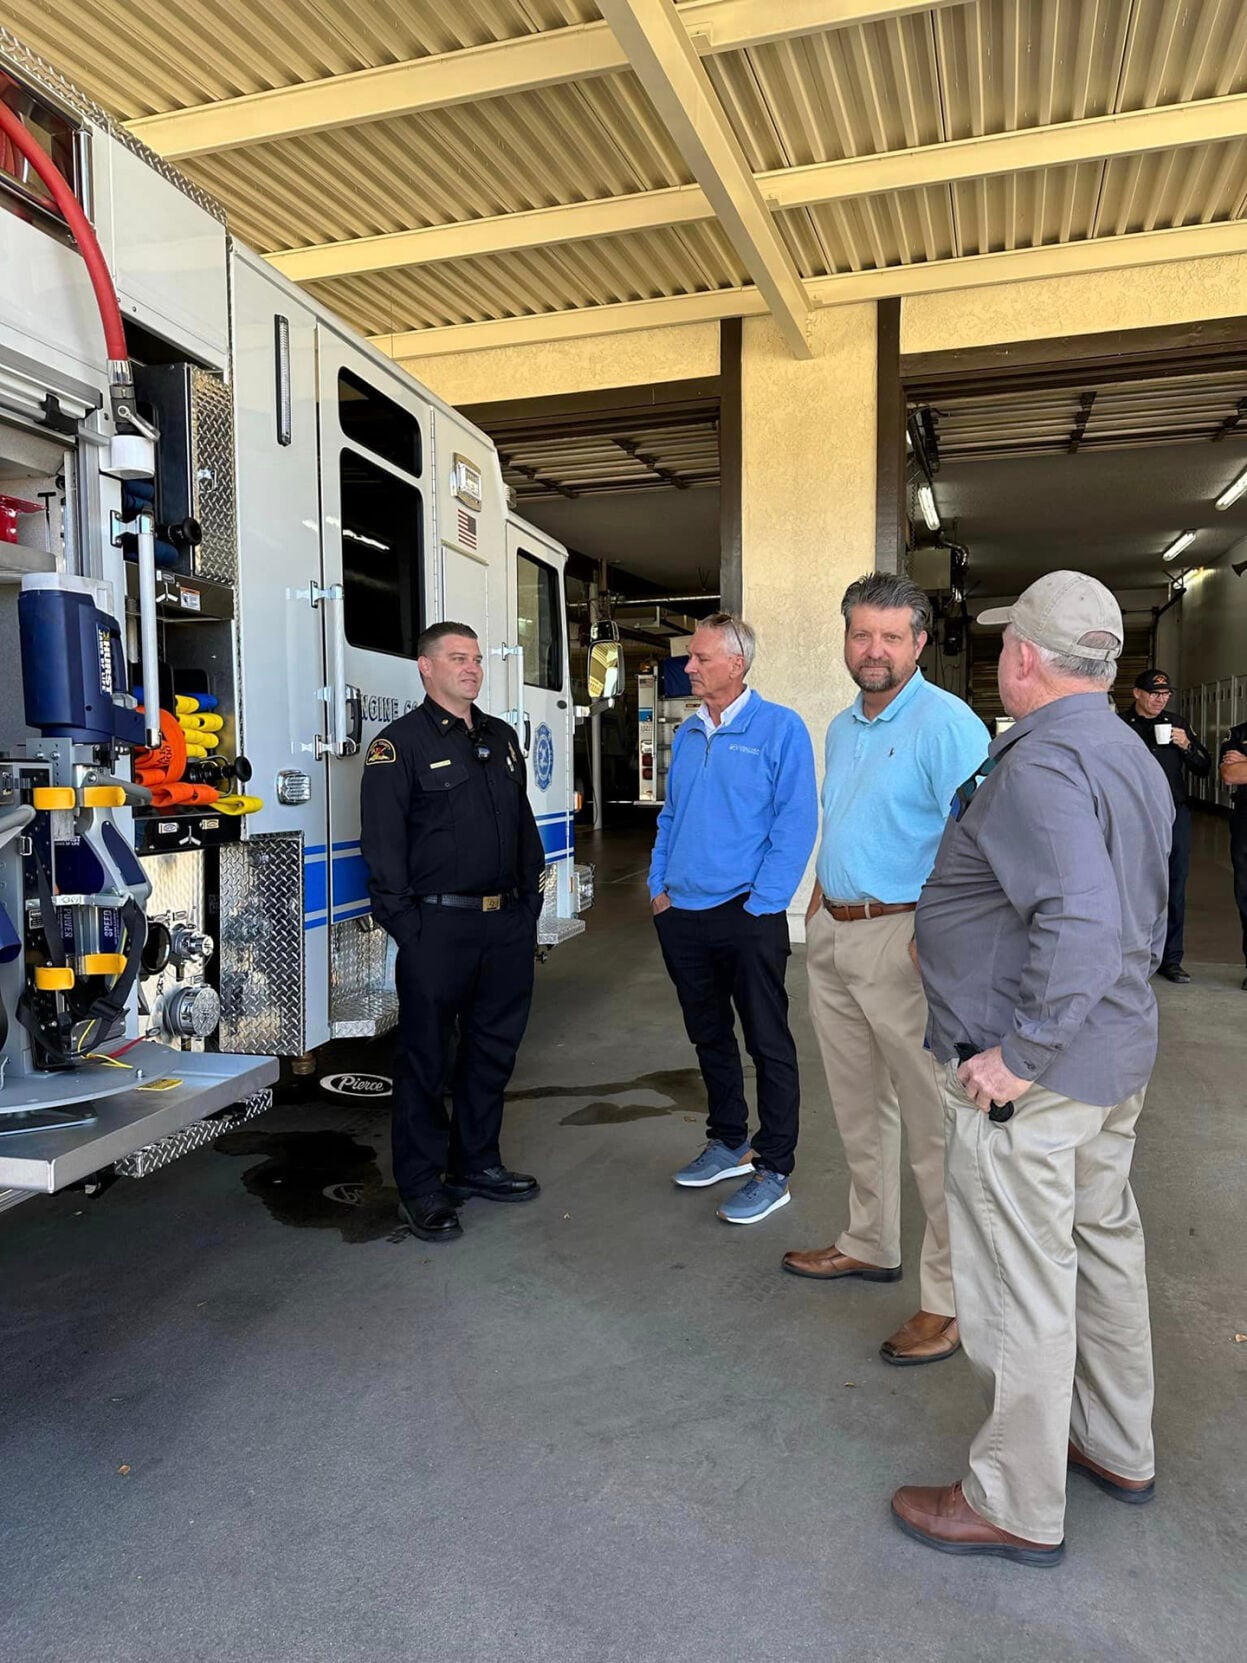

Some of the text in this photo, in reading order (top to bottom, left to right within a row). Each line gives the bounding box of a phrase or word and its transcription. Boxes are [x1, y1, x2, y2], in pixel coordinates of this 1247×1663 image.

[103, 641, 112, 696] HURST
[361, 694, 398, 722] NGINE
[64, 908, 73, 938] POWER
[103, 910, 113, 937] SPEED
[338, 1075, 384, 1091] Pierce
